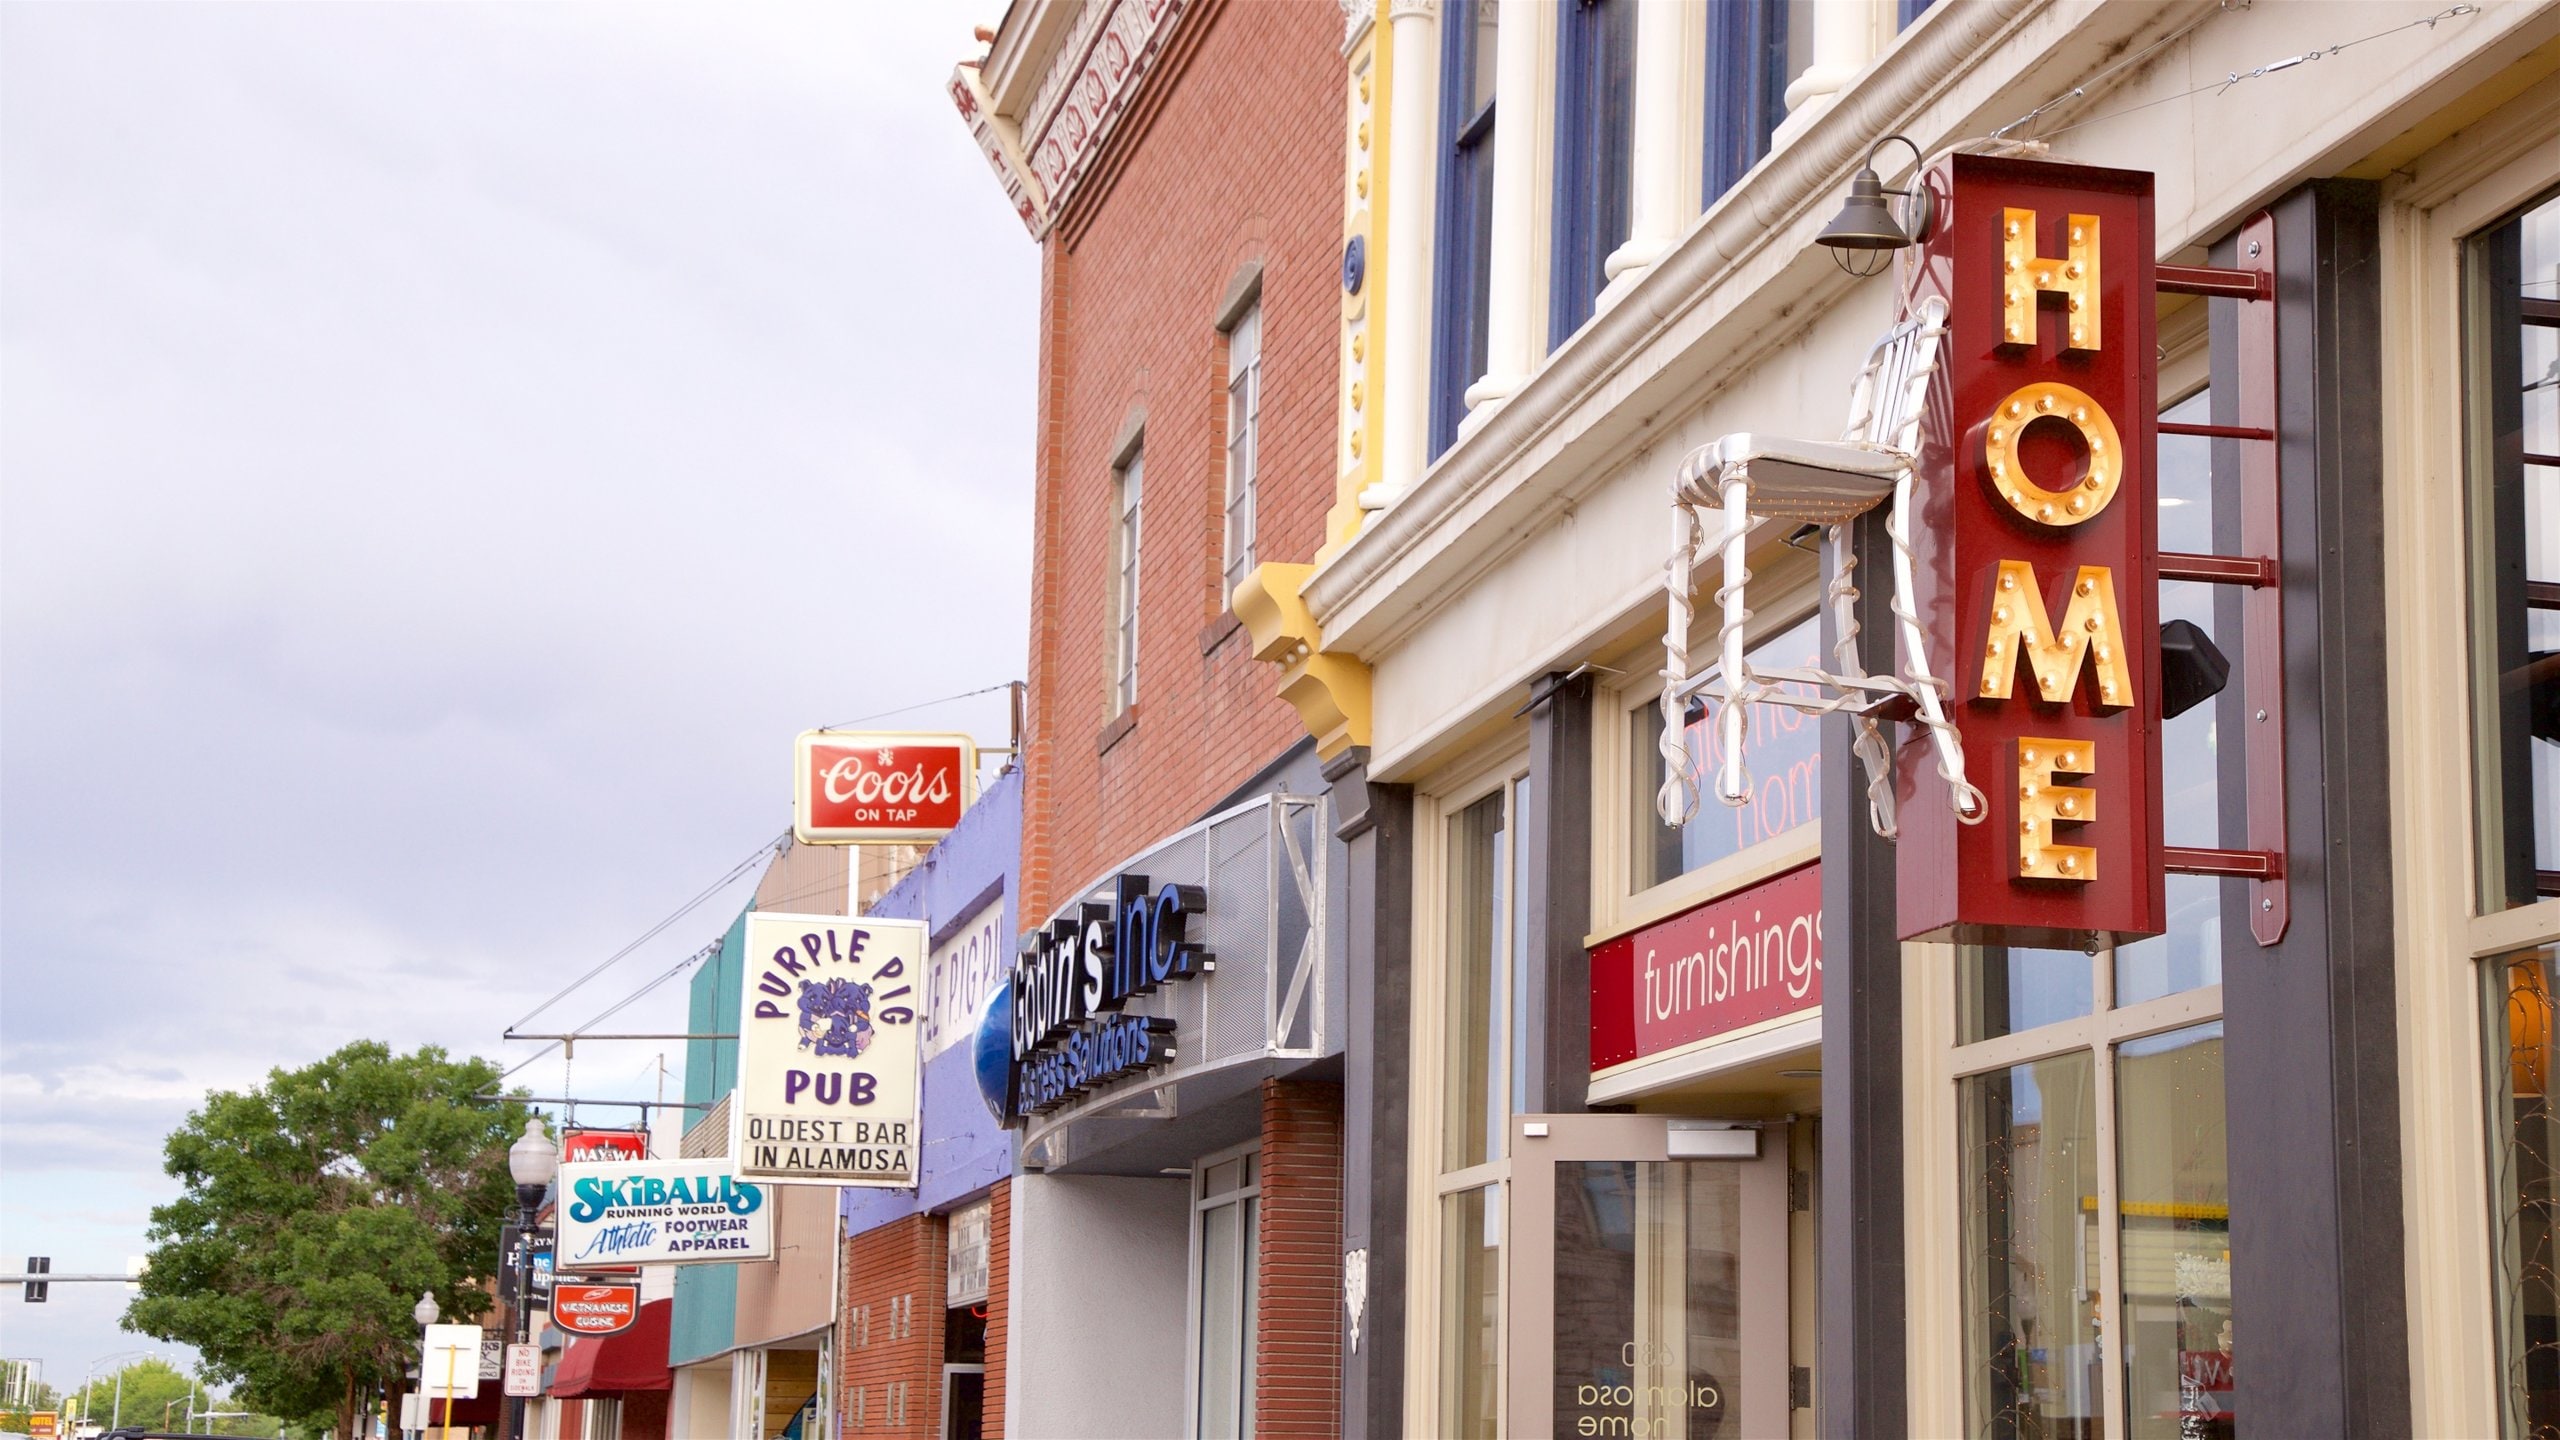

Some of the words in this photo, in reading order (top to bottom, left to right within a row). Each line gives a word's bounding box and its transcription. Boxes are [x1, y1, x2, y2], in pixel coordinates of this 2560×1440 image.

[1974, 206, 2135, 883] HOME
[819, 756, 951, 804] Coors
[855, 808, 880, 821] ON
[886, 808, 917, 821] TAP
[755, 929, 870, 1019] PURPLE
[872, 956, 914, 1025] PIG
[948, 935, 978, 1025] PIG
[1013, 902, 1110, 1062] Gobin's
[1113, 873, 1198, 999] Inc.
[1066, 1014, 1155, 1089] Solutions
[785, 1069, 877, 1106] PUB
[750, 1118, 843, 1143] OLDEST
[856, 1122, 907, 1144] BAR
[754, 1146, 777, 1167] IN
[786, 1148, 909, 1171] ALAMOSA
[606, 1207, 673, 1219] RUNNING
[678, 1205, 726, 1216] WORLD
[575, 1220, 658, 1259] Athletic
[665, 1218, 748, 1233] FOOTWEAR
[668, 1237, 749, 1252] APPAREL
[561, 1302, 630, 1314] VIETNAMESE
[575, 1316, 615, 1328] CUISINE
